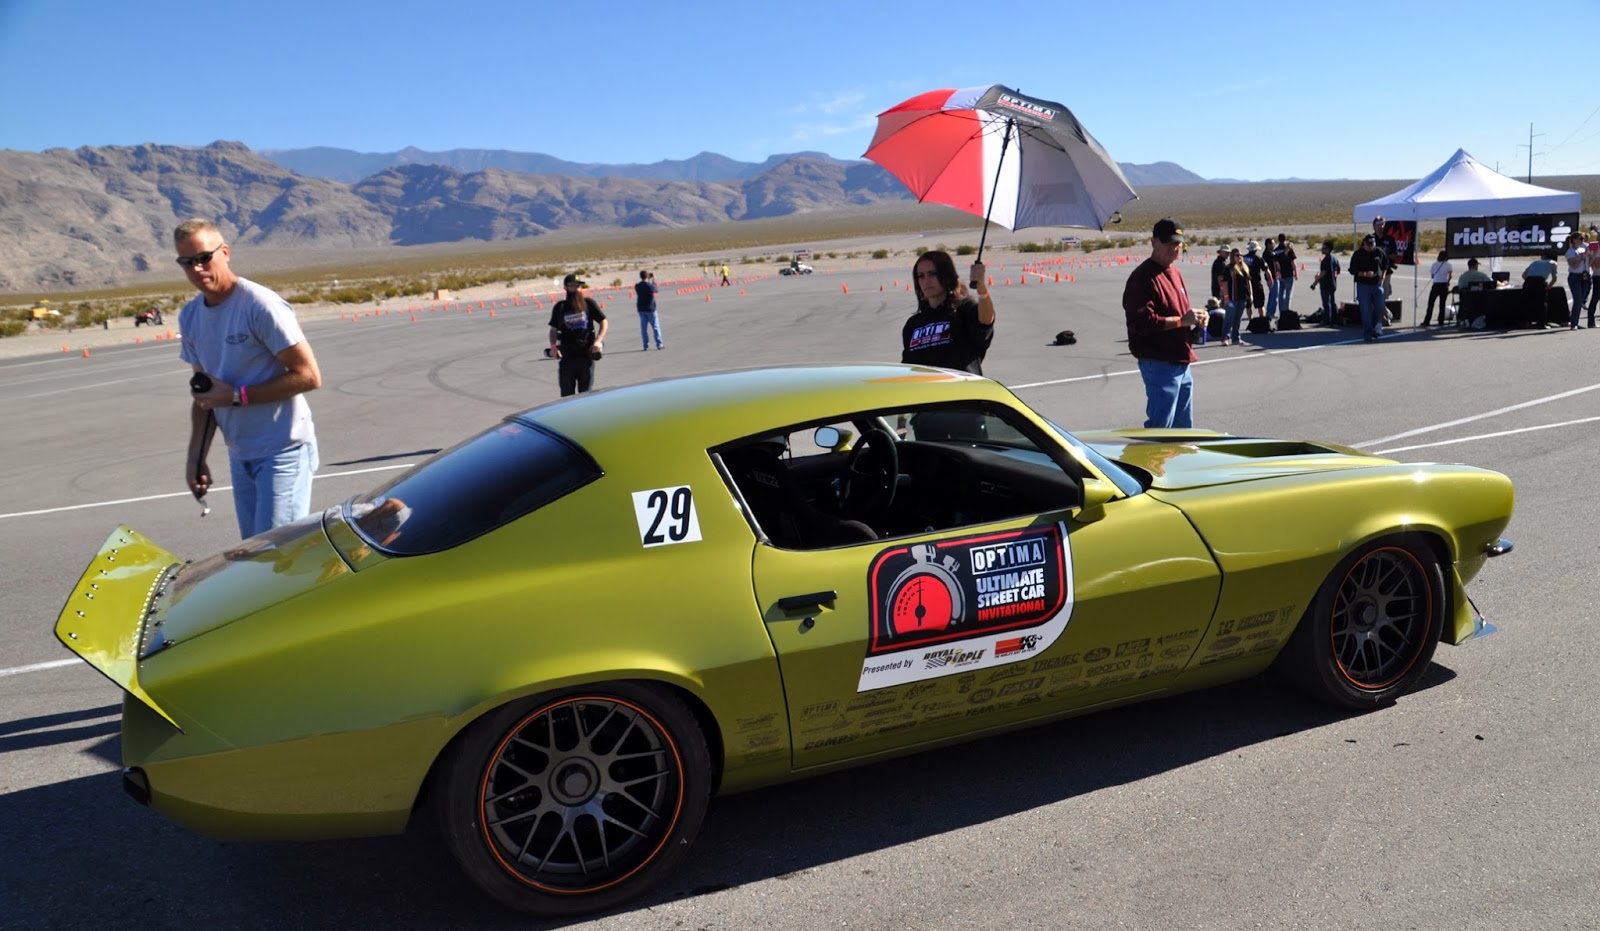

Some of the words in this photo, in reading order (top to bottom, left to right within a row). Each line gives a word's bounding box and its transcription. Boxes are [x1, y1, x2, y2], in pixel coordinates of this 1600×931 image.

[1002, 95, 1052, 115] OPTIMA
[1453, 225, 1545, 246] ridetech
[643, 487, 692, 545] 29
[974, 543, 1042, 570] OPTIMA
[976, 568, 1044, 594] ULTIMATE
[977, 588, 1020, 608] STREET
[1020, 584, 1045, 600] CAR
[977, 599, 1046, 621] INVITATIONAL
[922, 648, 954, 660] ROYAL
[943, 649, 987, 666] PURPLE
[862, 660, 901, 675] Presented
[902, 659, 914, 669] by
